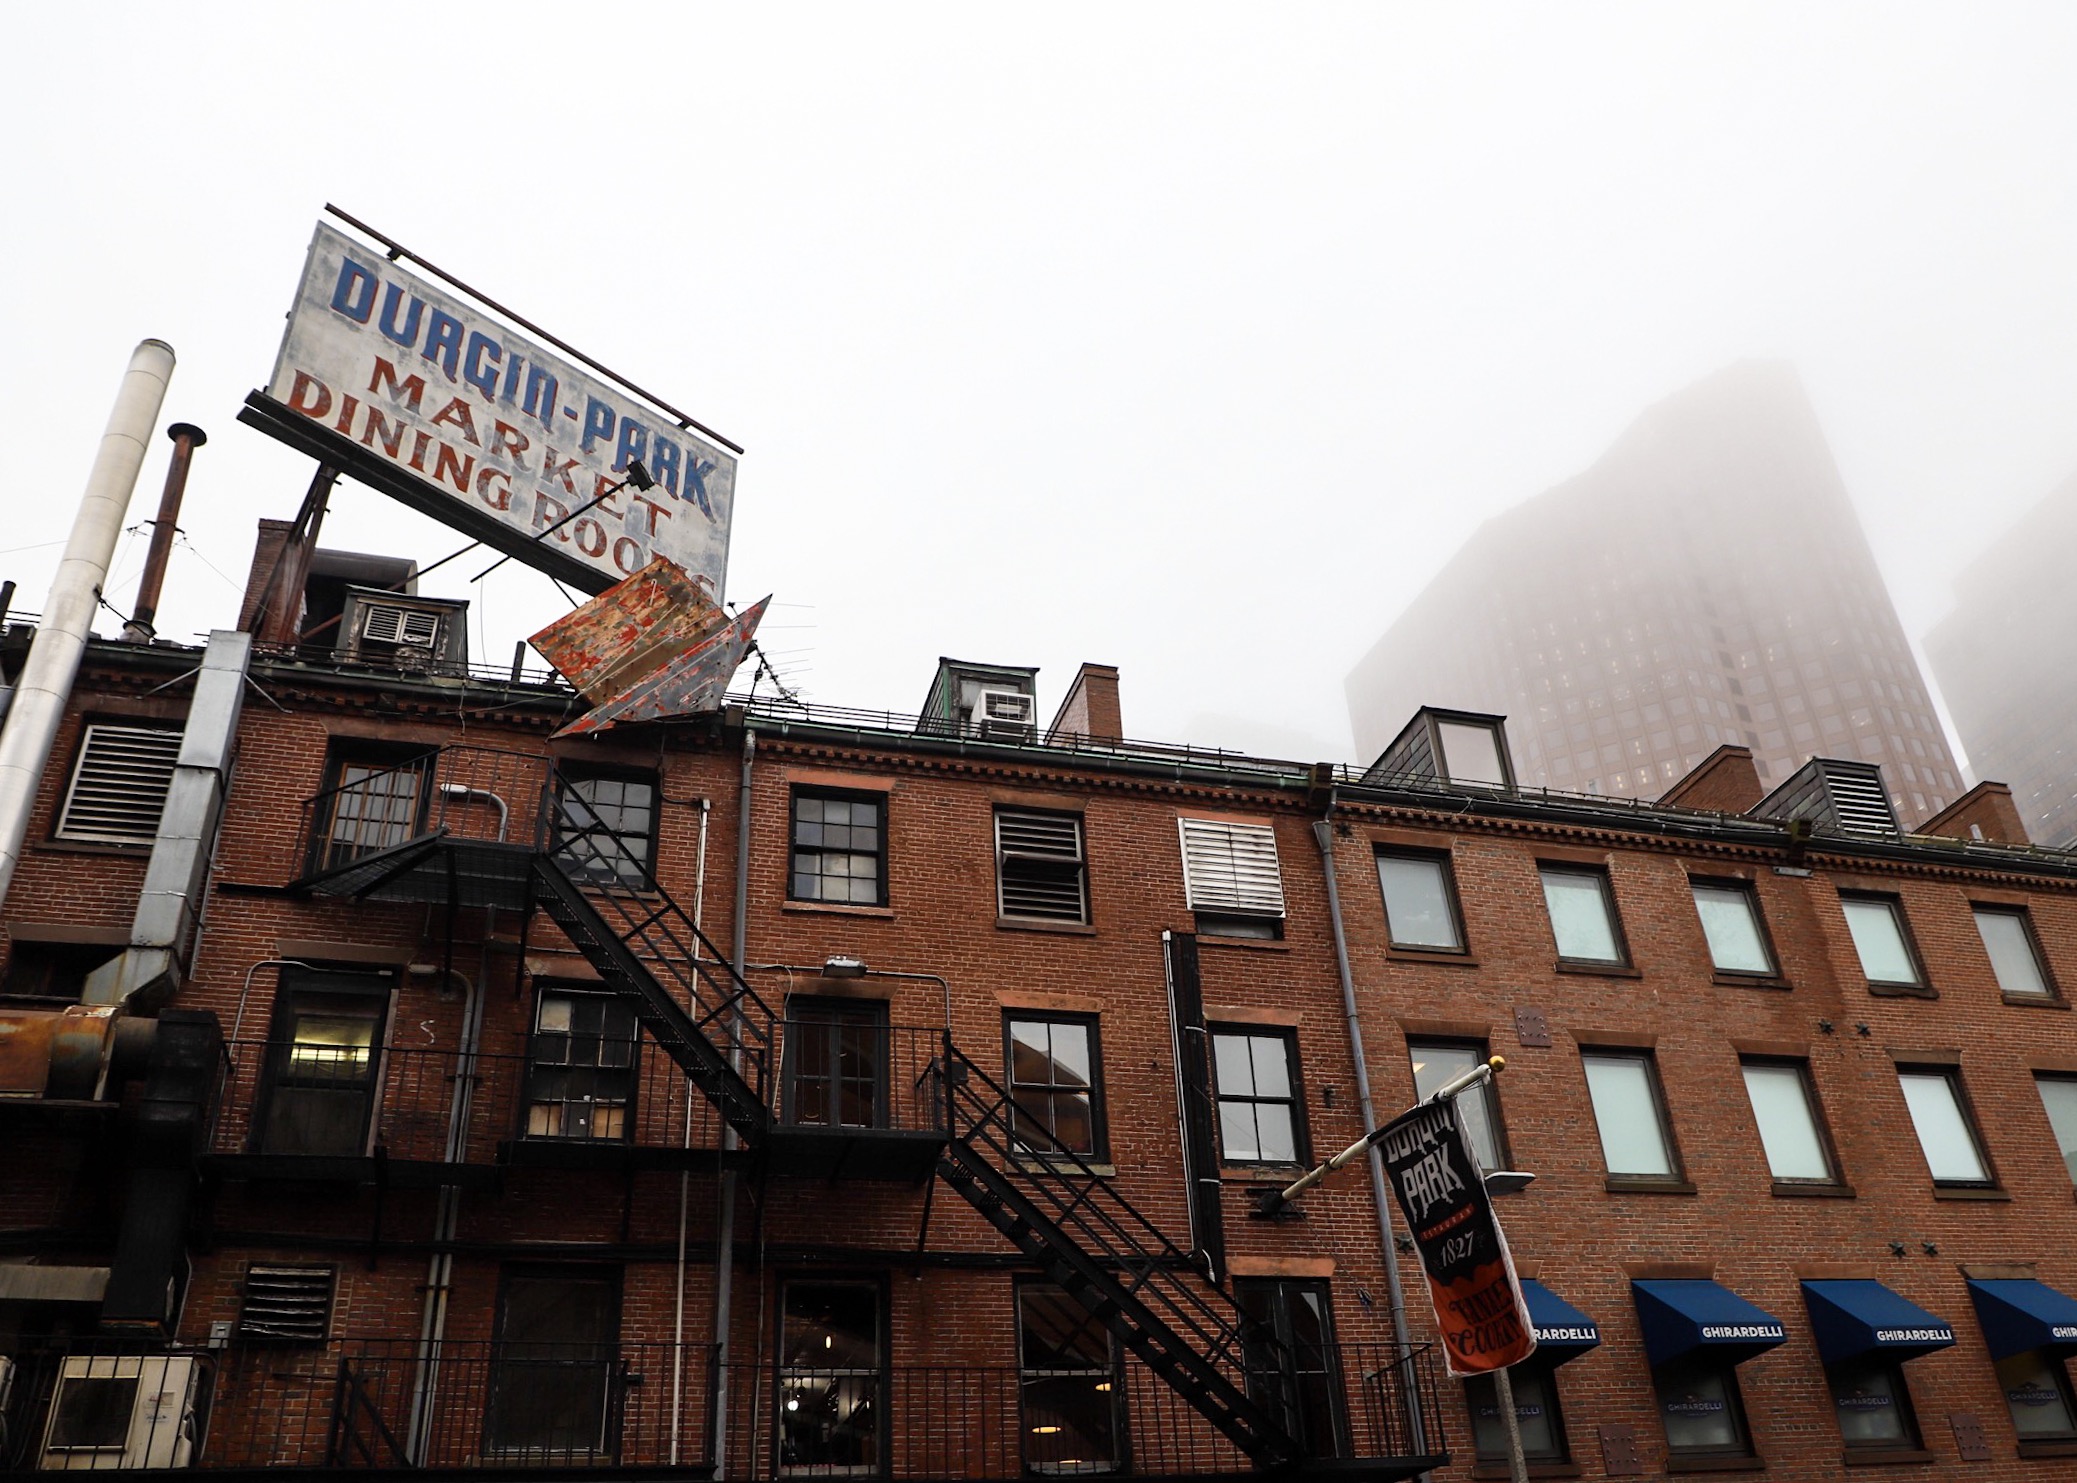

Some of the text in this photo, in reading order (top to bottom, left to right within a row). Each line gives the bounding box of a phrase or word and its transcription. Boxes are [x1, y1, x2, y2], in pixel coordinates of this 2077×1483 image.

[330, 256, 717, 525] DURGIN-PARK
[368, 355, 672, 538] MARKET
[286, 369, 716, 594] DINING ROO
[1400, 1141, 1466, 1224] PARK
[1440, 1230, 1475, 1269] 1827
[1534, 1328, 1597, 1340] RARDELLI
[1702, 1326, 1783, 1338] GHIRARDELLI
[1876, 1329, 1953, 1342] GHIRARDELLI
[1667, 1402, 1723, 1412] GHIRARDELLI
